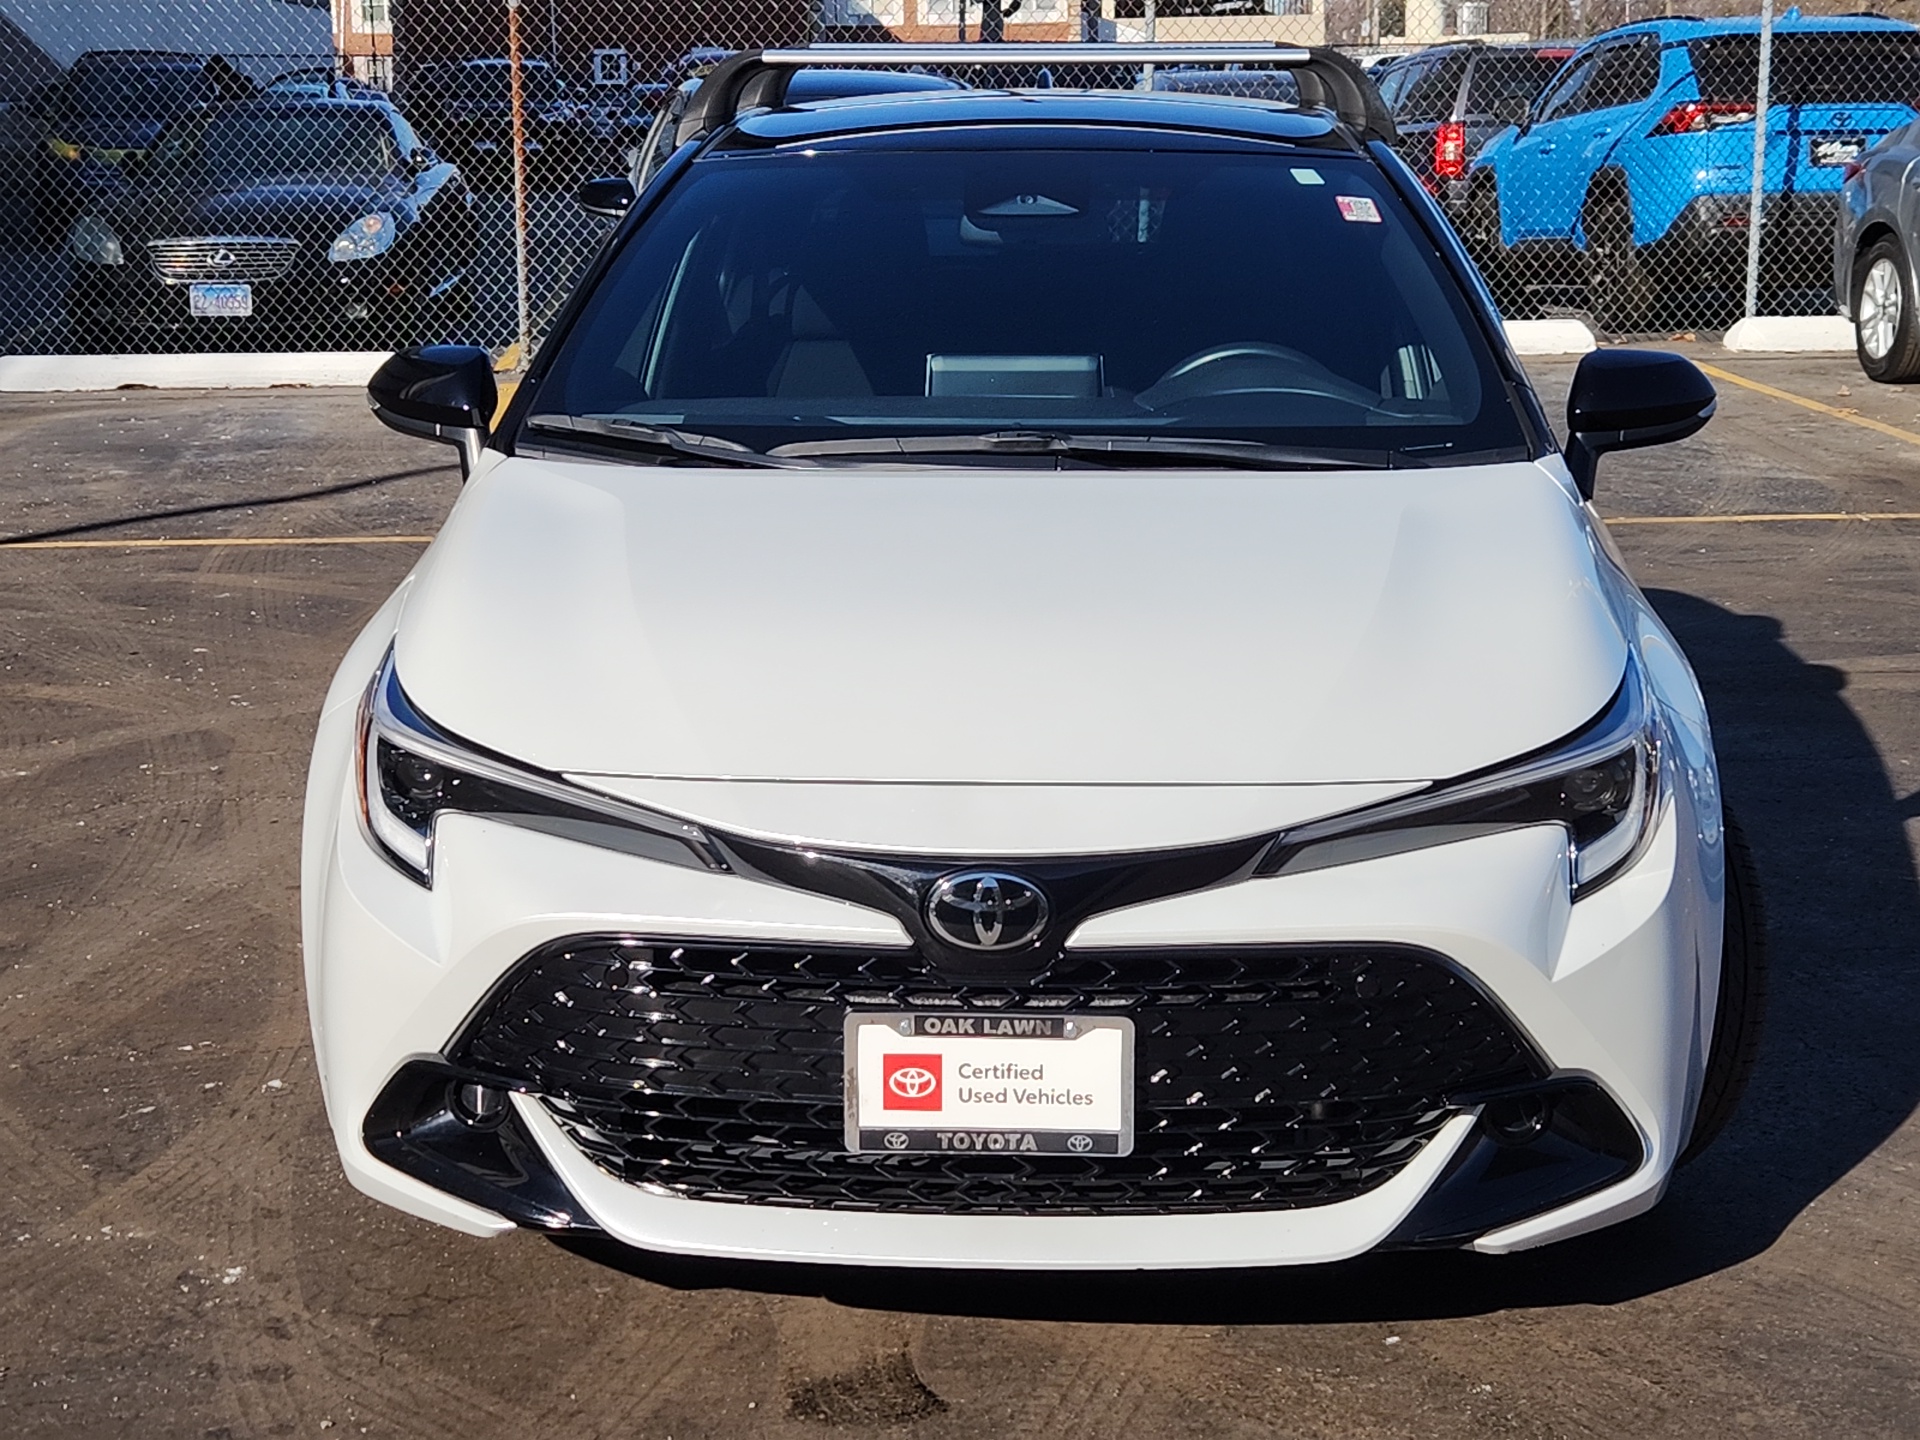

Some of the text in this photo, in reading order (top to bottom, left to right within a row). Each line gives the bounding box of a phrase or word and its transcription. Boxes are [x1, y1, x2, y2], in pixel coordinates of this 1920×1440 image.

[923, 1017, 1052, 1035] OAK LAWN
[958, 1063, 1044, 1080] Certified
[958, 1087, 1094, 1106] Used Vehicles
[936, 1132, 1038, 1151] TOYOTA
